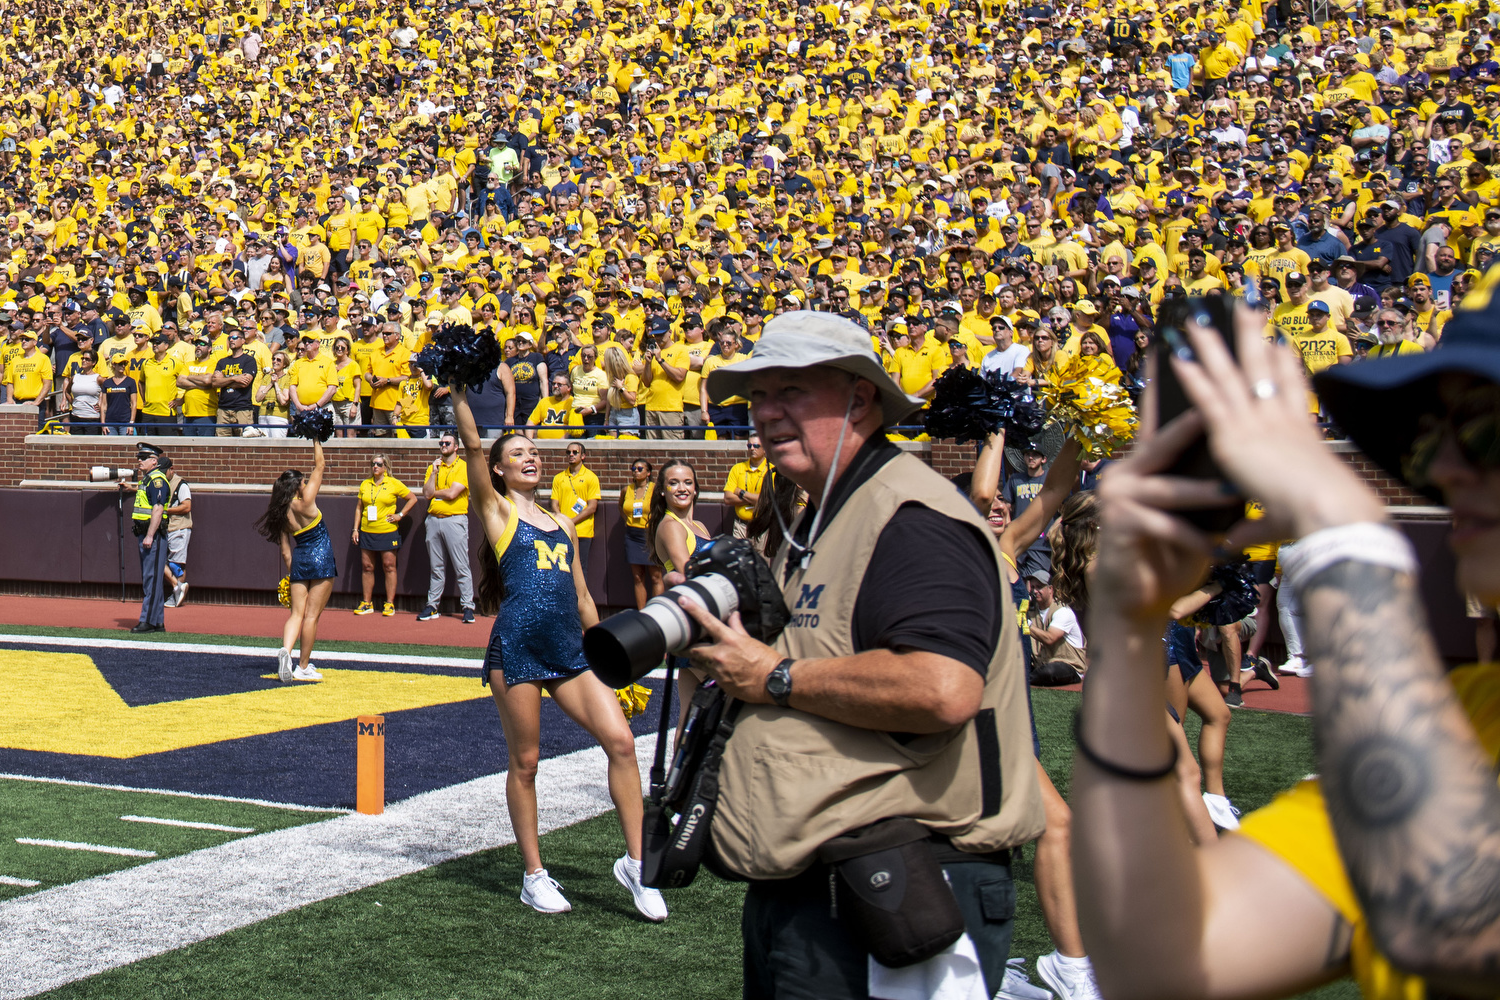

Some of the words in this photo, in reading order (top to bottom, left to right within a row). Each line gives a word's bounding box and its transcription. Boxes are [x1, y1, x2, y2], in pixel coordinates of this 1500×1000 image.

[1113, 22, 1130, 38] 10
[1268, 259, 1297, 269] MICHIGAN
[358, 270, 369, 279] M
[1191, 288, 1203, 296] M
[1282, 317, 1293, 325] GO
[1300, 340, 1336, 351] 2023
[130, 358, 145, 370] M
[546, 408, 567, 425] M
[534, 539, 571, 573] M
[795, 584, 826, 609] M
[359, 722, 374, 736] M
[674, 803, 706, 851] Canon
